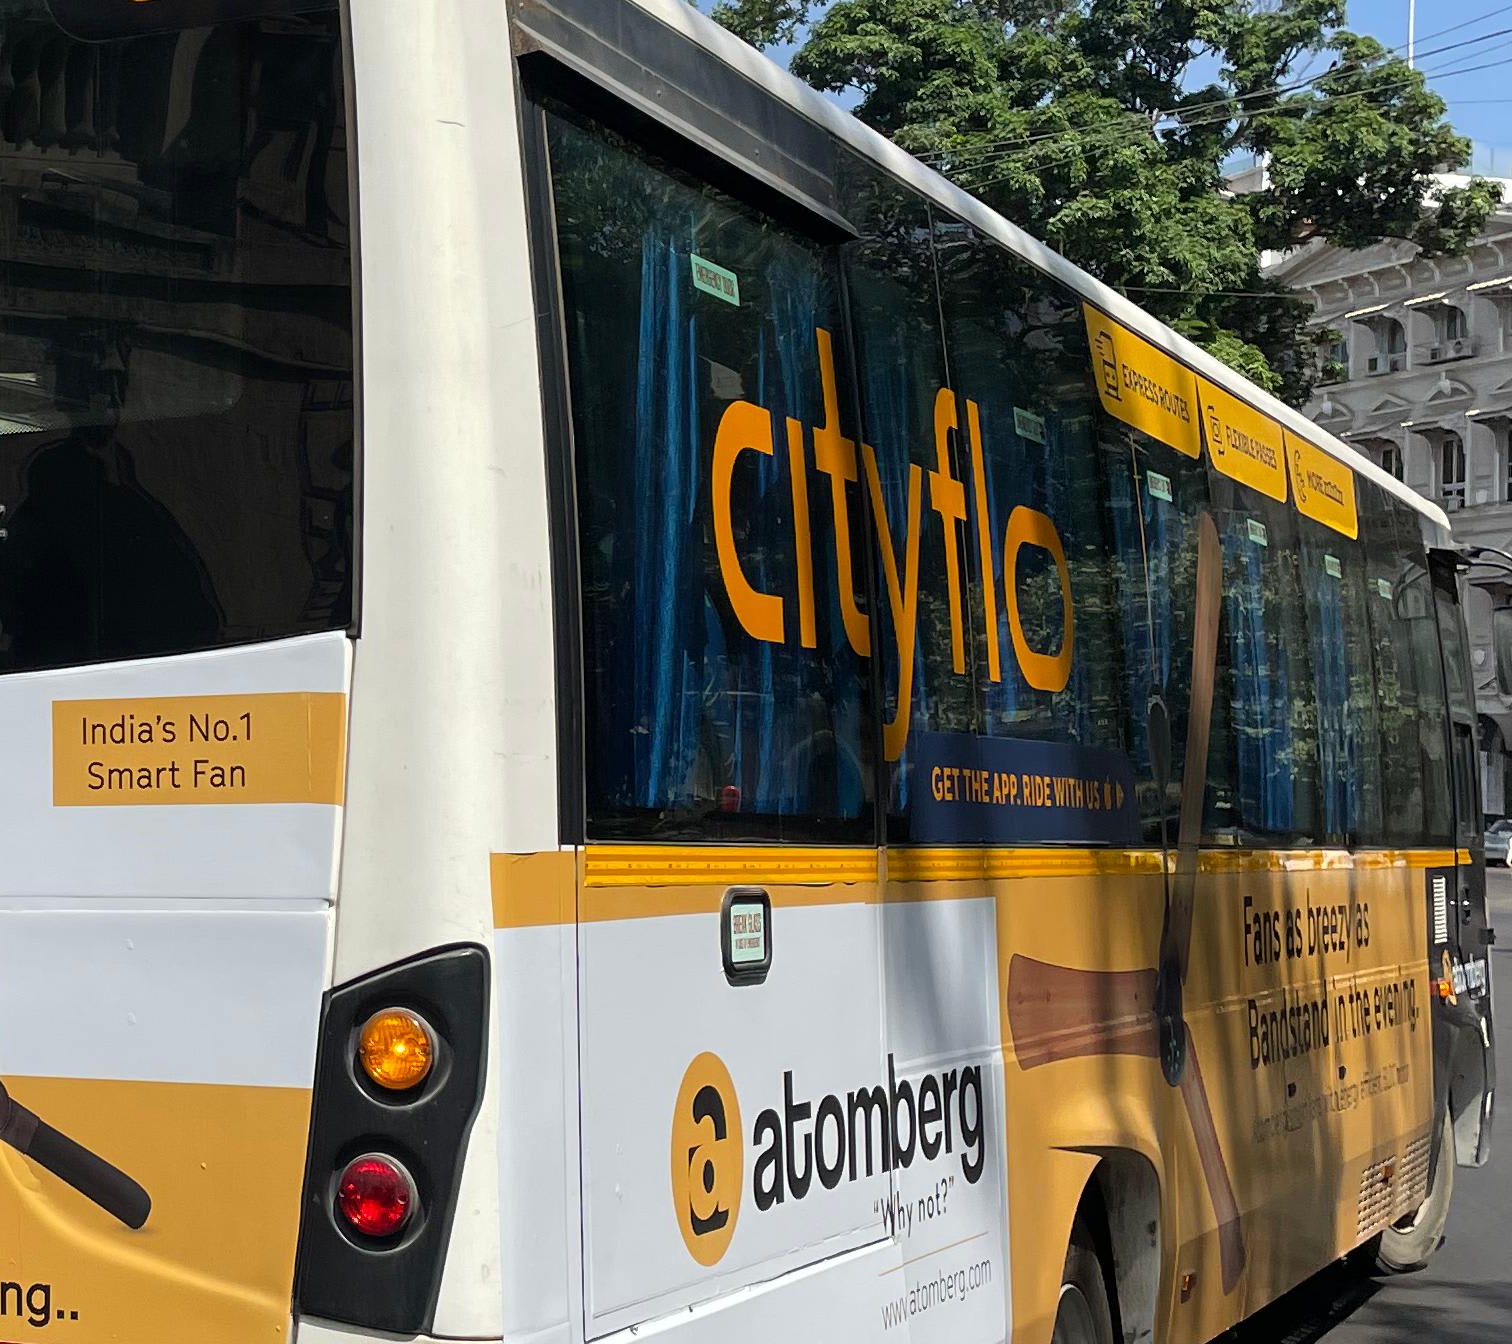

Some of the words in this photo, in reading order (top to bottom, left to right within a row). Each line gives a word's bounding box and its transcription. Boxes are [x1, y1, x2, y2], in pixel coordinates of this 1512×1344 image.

[1121, 362, 1159, 406] EXPRESS
[1158, 385, 1191, 423] ROUTES
[712, 328, 1073, 762] cityflo
[189, 712, 252, 742] No.1
[88, 760, 181, 790] Smart
[193, 759, 246, 788] Fan
[931, 766, 959, 801] GET
[962, 768, 989, 803] THE
[992, 772, 1021, 806] APP.
[1022, 773, 1052, 807] RIDE
[1053, 776, 1083, 809] WITH
[1086, 779, 1100, 810] US
[1243, 895, 1282, 967] Fans
[1285, 907, 1303, 959] as
[1306, 887, 1351, 964] breezy
[1355, 902, 1370, 948] as
[1247, 978, 1330, 1071] Bandstand
[1332, 976, 1348, 1044] in
[1348, 974, 1371, 1038] the
[753, 1053, 985, 1212] atomberg
[881, 1259, 992, 1330] wwwatomberg.com
